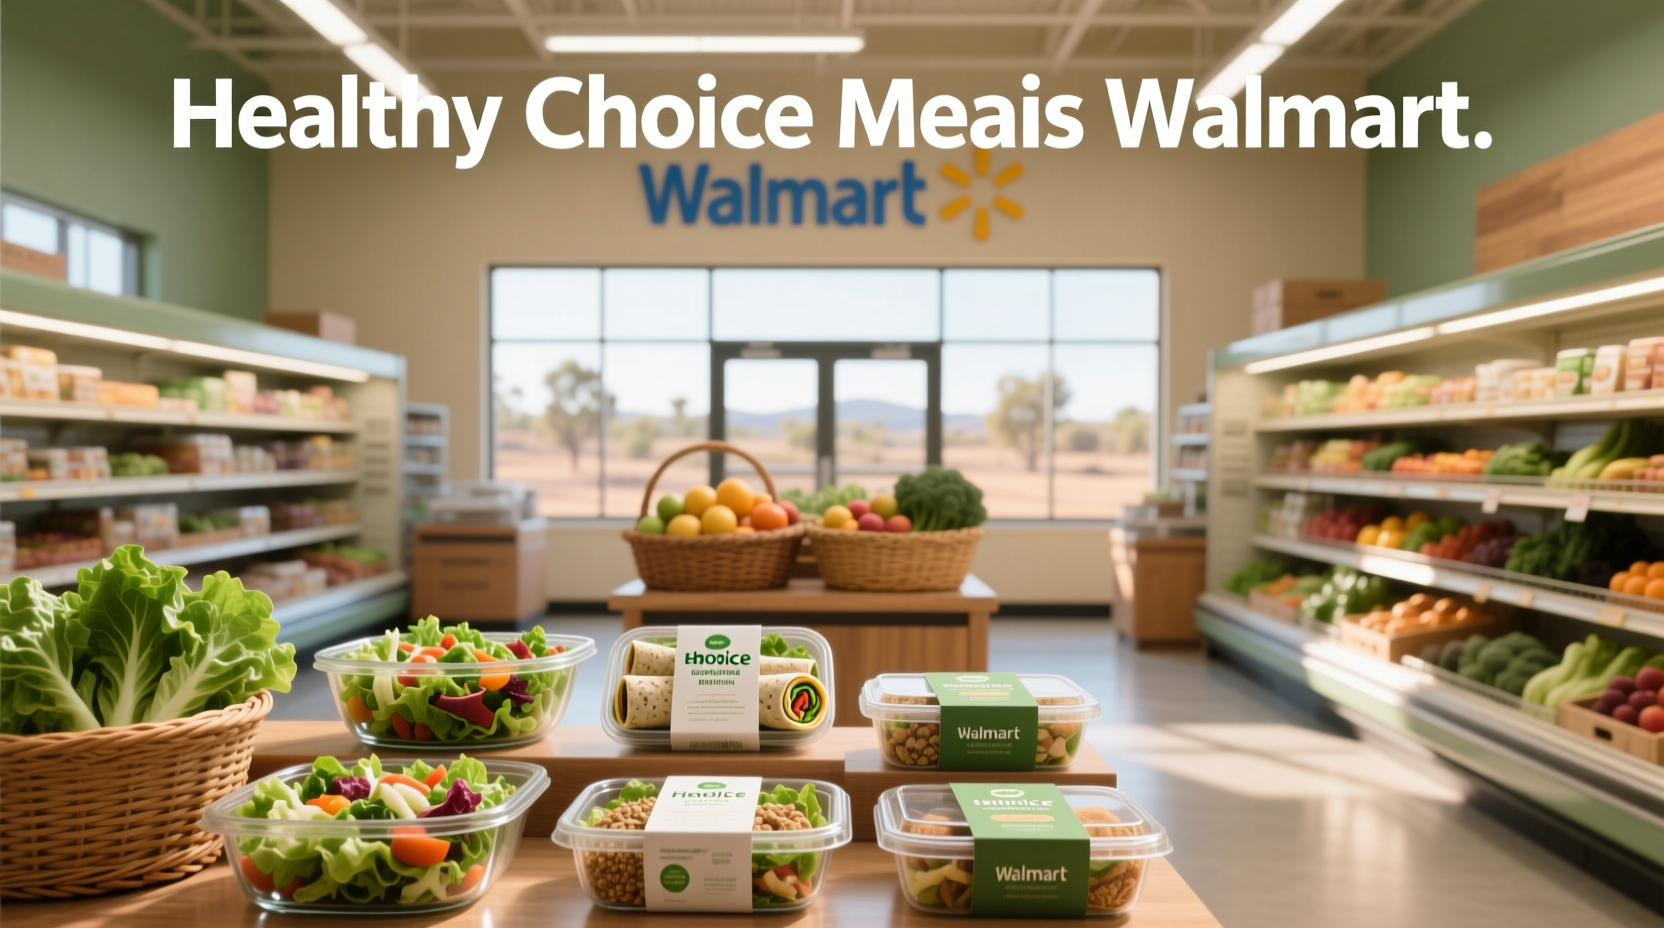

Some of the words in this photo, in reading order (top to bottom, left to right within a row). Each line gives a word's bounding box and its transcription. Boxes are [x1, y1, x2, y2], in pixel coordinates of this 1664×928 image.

[638, 160, 927, 227] Walmart
[957, 726, 1020, 740] Walmart
[995, 865, 1068, 882] Walmart
